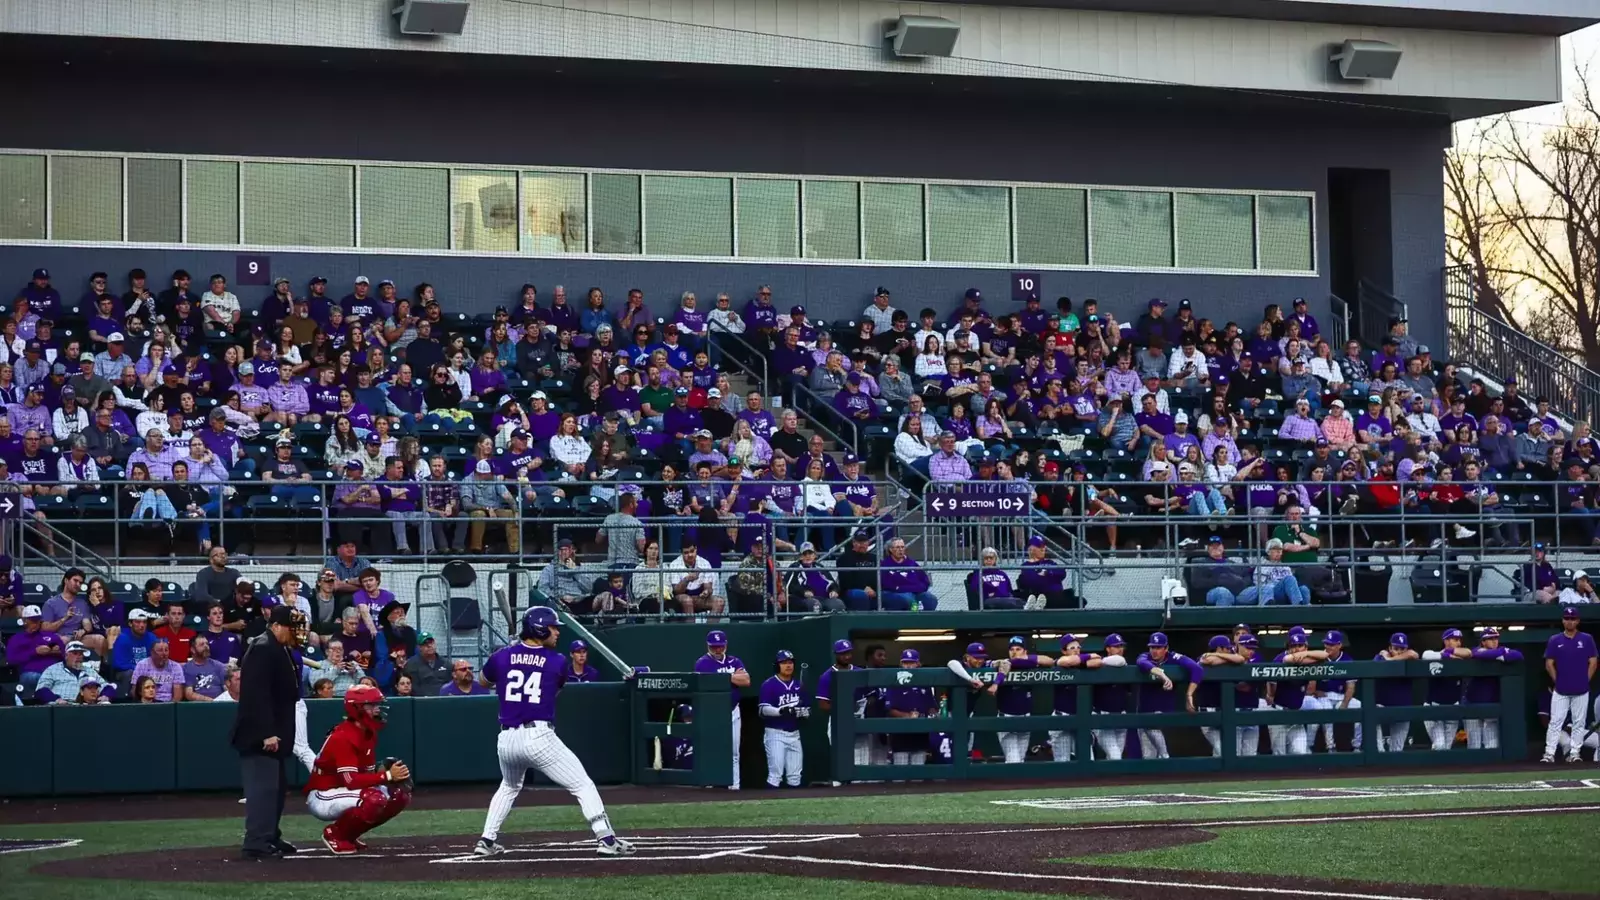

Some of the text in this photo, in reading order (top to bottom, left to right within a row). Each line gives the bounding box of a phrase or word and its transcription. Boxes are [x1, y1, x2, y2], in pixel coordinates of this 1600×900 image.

[248, 261, 258, 274] 9
[1018, 278, 1034, 291] 10
[949, 498, 1012, 510] 9 SECTION 10
[510, 653, 547, 668] DARDAR
[972, 670, 1074, 683] K-STTESPORTS.COM
[505, 669, 543, 704] 24
